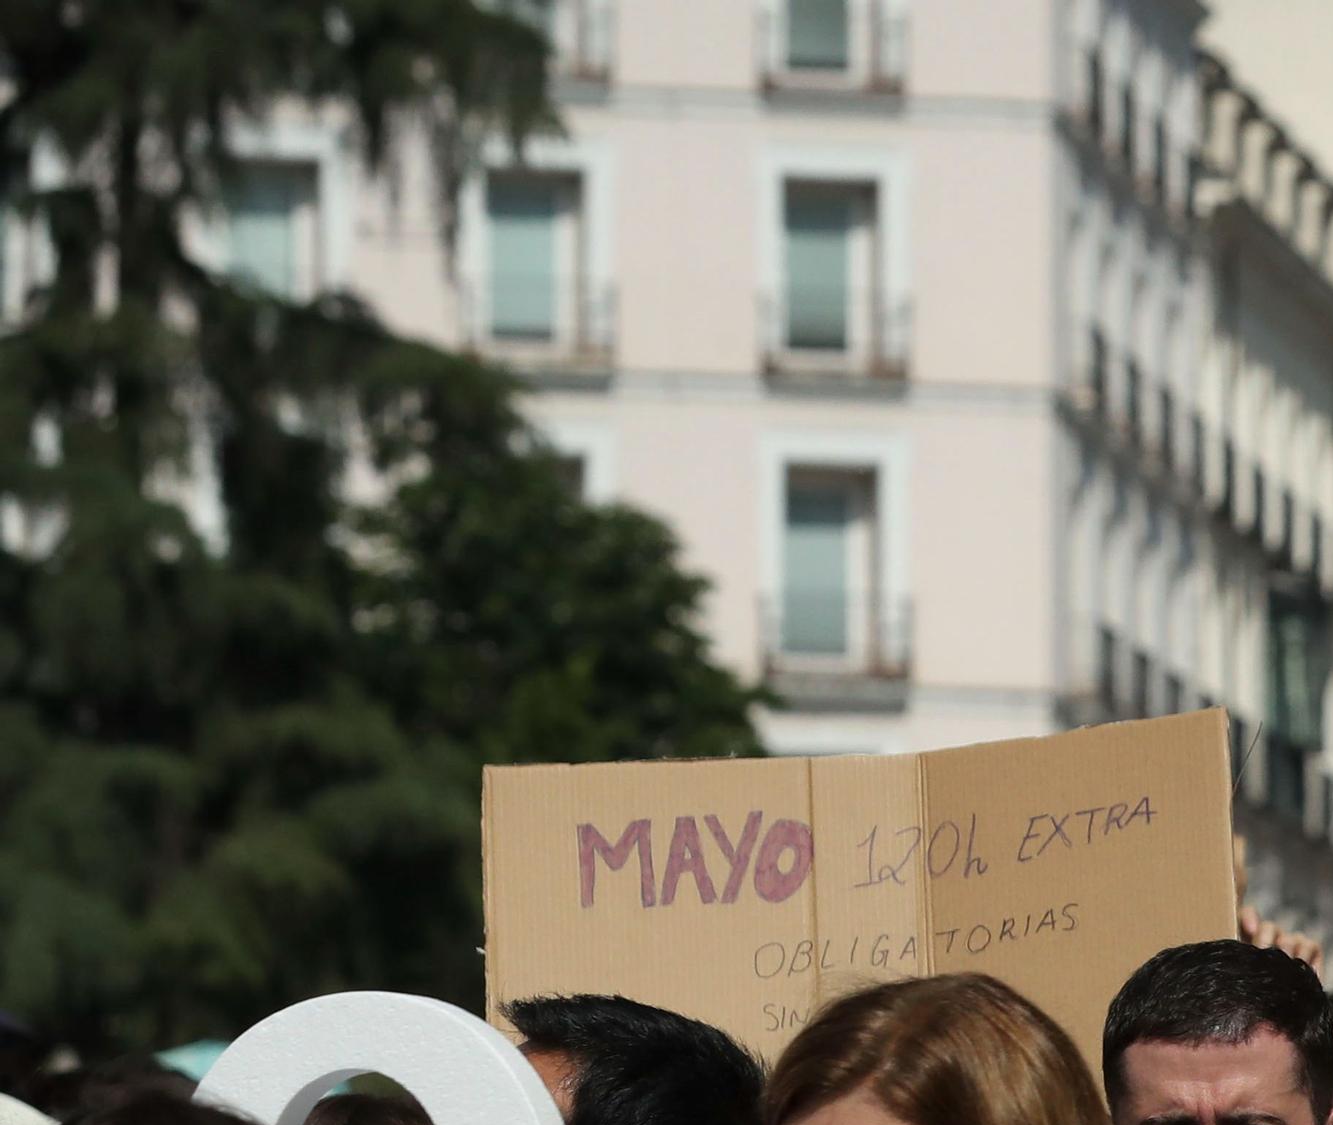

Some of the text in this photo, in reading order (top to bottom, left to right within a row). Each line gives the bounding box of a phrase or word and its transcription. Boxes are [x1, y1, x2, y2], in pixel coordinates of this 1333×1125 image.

[577, 795, 1158, 909] MAYO 120h EXTRA
[754, 902, 1080, 979] OBLIGATORIAS
[762, 1003, 811, 1032] SIN
